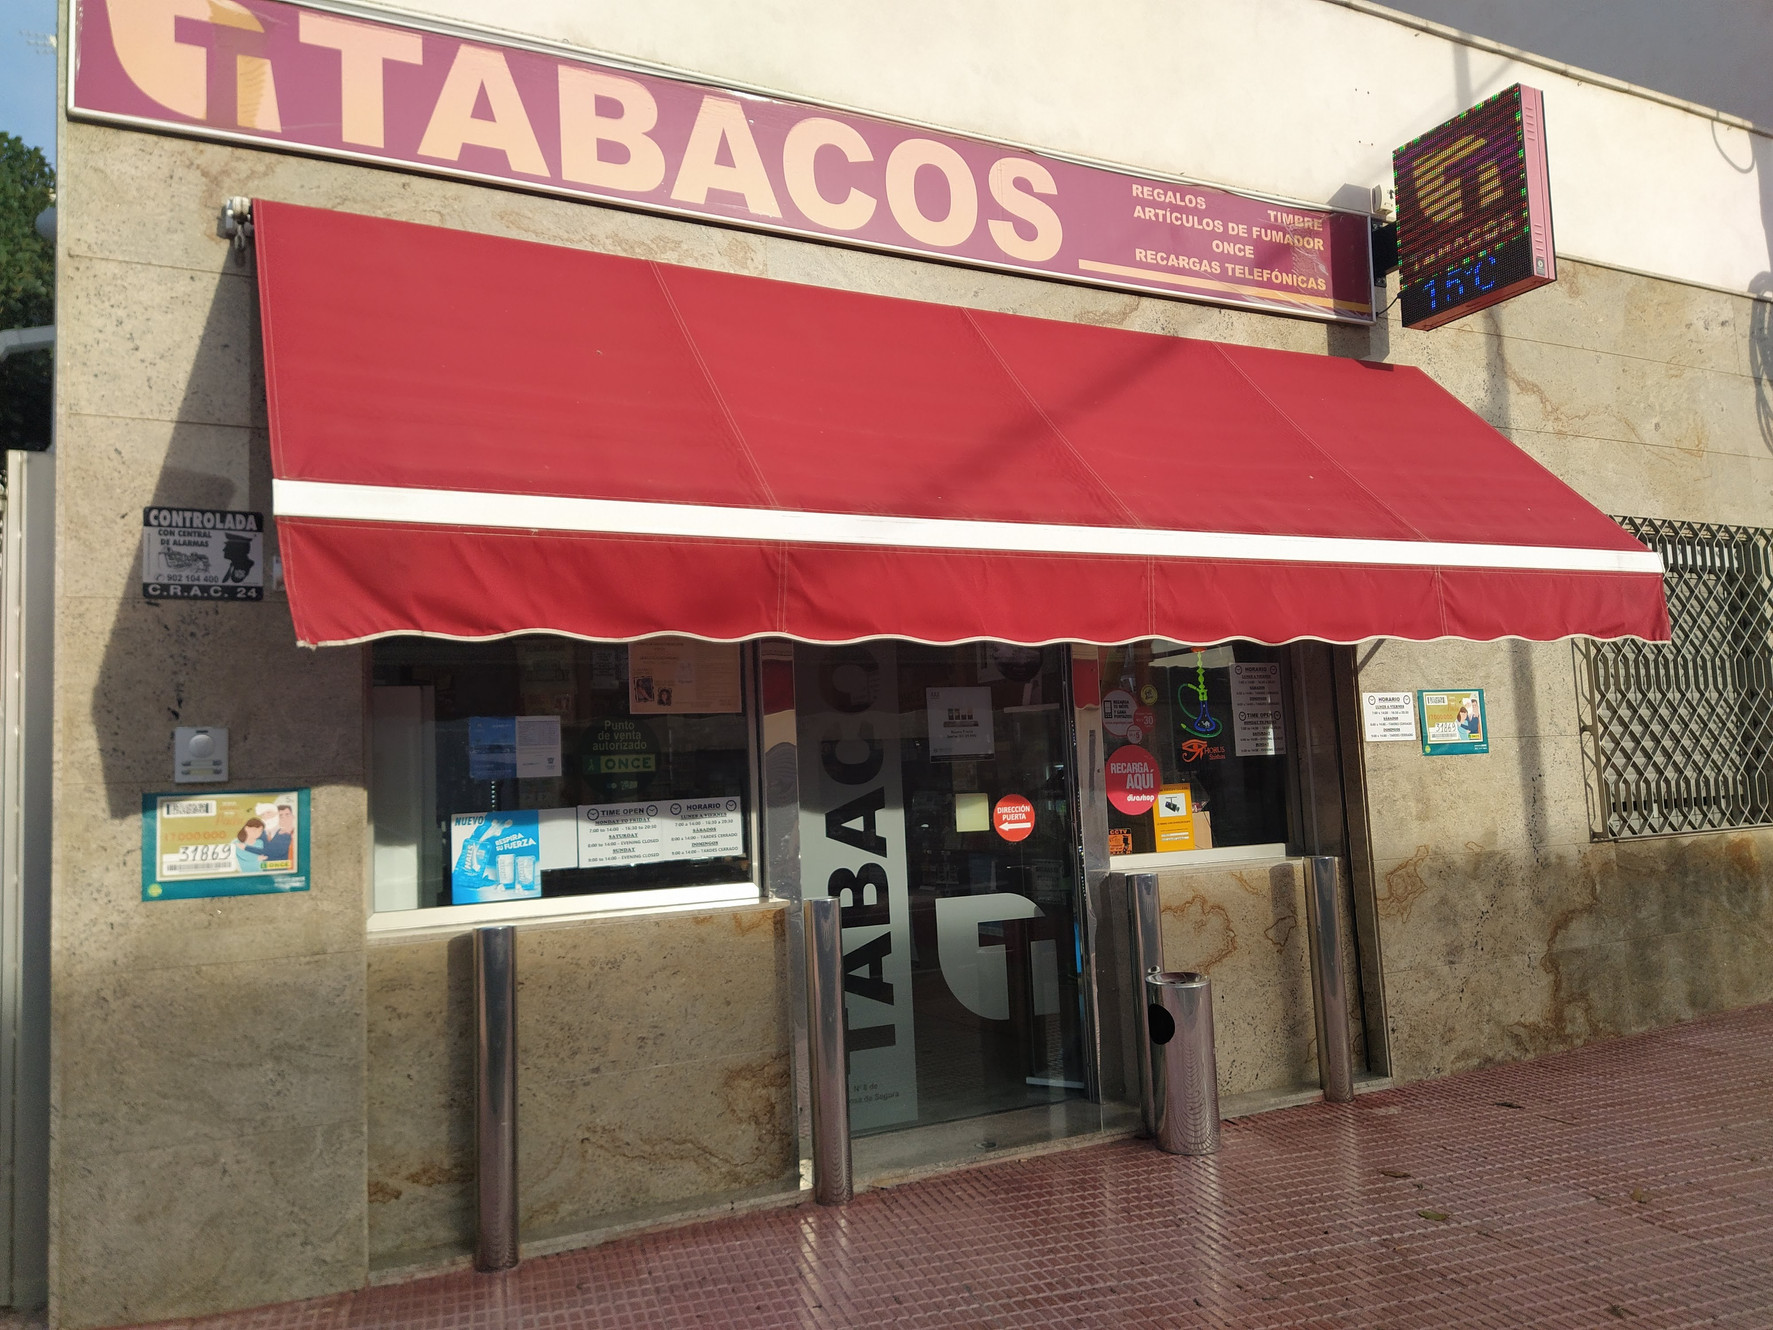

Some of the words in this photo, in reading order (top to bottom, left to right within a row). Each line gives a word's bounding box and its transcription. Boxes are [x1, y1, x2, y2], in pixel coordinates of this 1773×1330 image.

[299, 12, 1063, 263] TABACOS
[1132, 184, 1206, 210] REGALOS
[1267, 210, 1323, 231] TIMBRE
[1133, 205, 1223, 233] ARTÍCULOS
[1228, 222, 1248, 238] DE
[1252, 227, 1324, 251] FUMADOR
[1212, 240, 1255, 258] ONCE
[1135, 248, 1221, 274] RECARGAS
[1224, 263, 1327, 291] TELEFÓNICAS
[149, 509, 257, 531] CONTROLADA
[158, 529, 175, 537] CON
[178, 530, 212, 539] CENTRAL
[173, 539, 209, 547] ALARMAS
[167, 574, 182, 582] 902
[148, 584, 228, 598] C.R.A.C.
[236, 587, 258, 598] 24
[604, 719, 635, 732] Punto
[598, 730, 611, 741] de
[613, 730, 642, 741] venta
[592, 738, 647, 751] autorizado
[605, 757, 651, 770] ONCE
[1110, 762, 1149, 774] RECARGA
[1126, 769, 1154, 790] AQUÍ
[1127, 793, 1155, 803] disashop
[623, 807, 645, 815] OPEN
[686, 803, 721, 811] HORARIO
[997, 804, 1031, 814] DIRECCIÓN
[454, 816, 485, 827] NUEVO
[1002, 813, 1027, 821] PUERTA
[495, 833, 524, 846] RESPIRA
[504, 838, 537, 851] FUERZA
[179, 843, 232, 862] 31869
